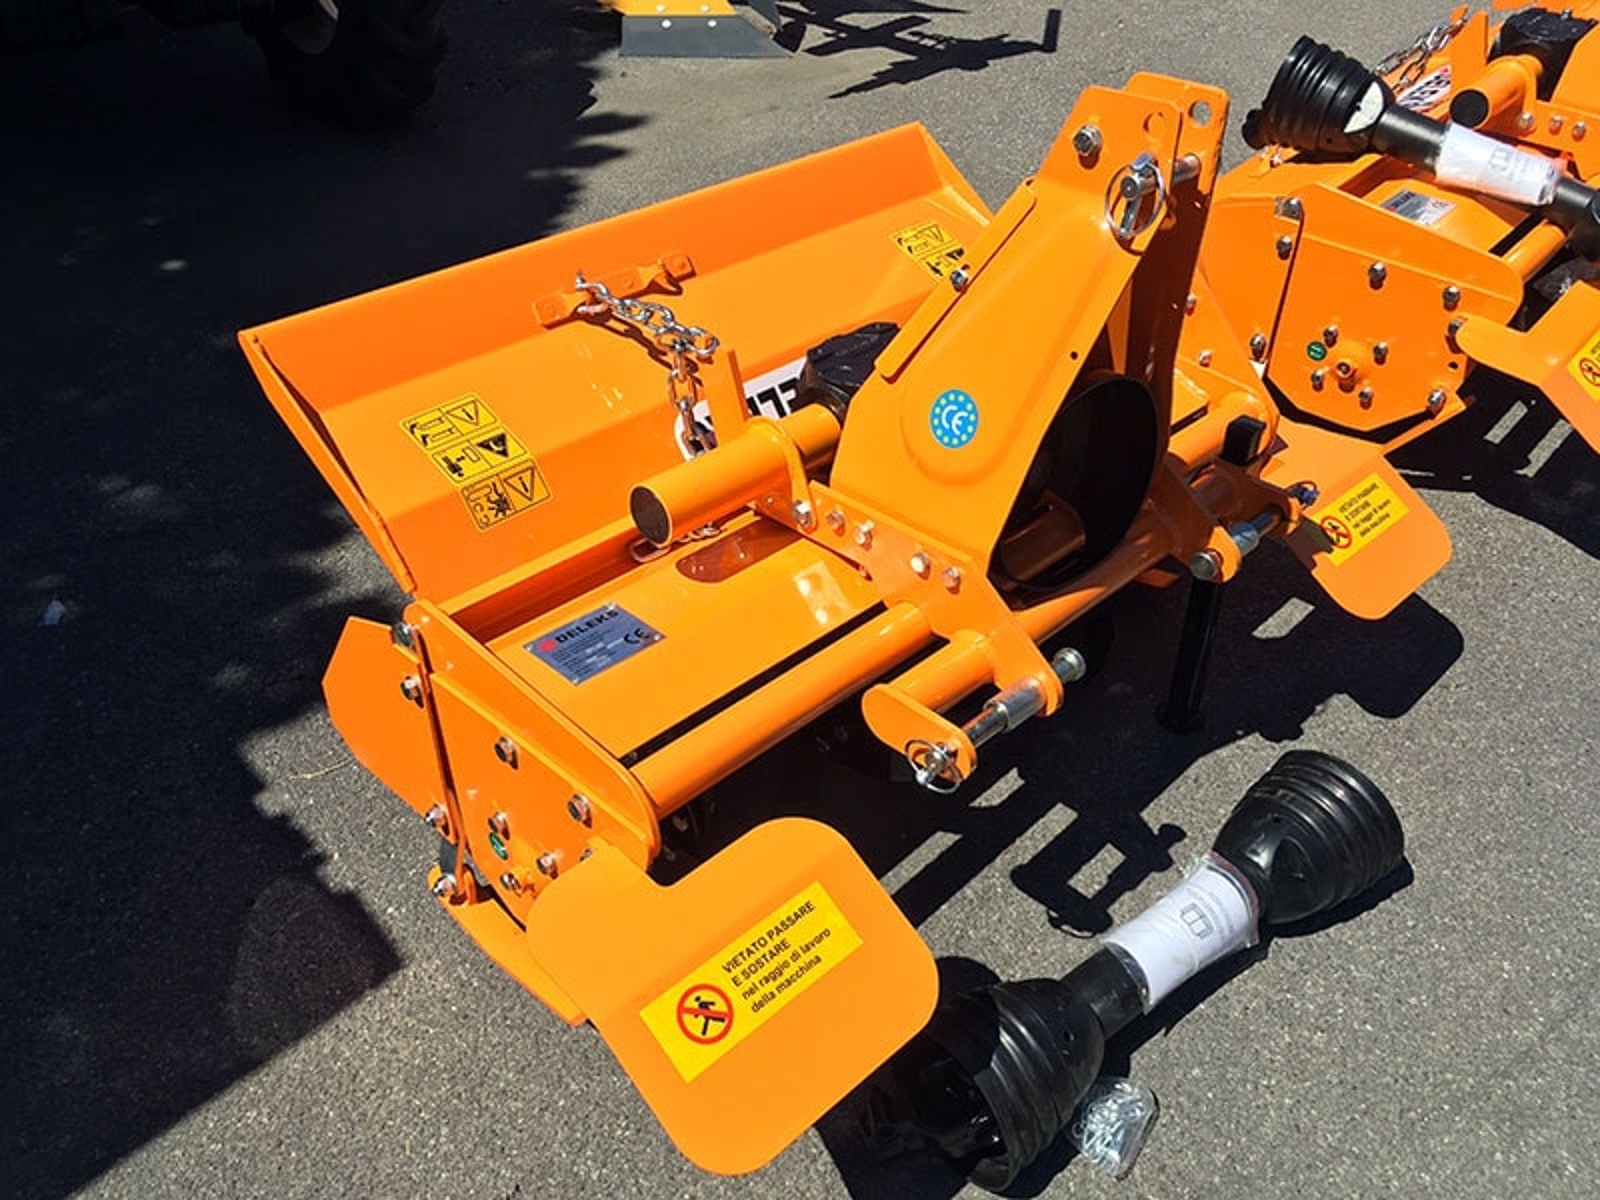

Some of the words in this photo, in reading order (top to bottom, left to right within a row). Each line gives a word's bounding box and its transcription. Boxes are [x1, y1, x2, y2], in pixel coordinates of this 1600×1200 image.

[555, 609, 619, 643] DELEKS
[722, 937, 768, 973] VIETATO
[767, 901, 816, 939] PASSARE
[731, 976, 742, 987] E
[742, 938, 791, 980] SOSTARE
[742, 983, 758, 1000] nel
[759, 959, 791, 988] raggio
[790, 948, 801, 962] di
[800, 928, 832, 954] lavoro
[751, 990, 776, 1013] della
[776, 955, 822, 993] macchina
